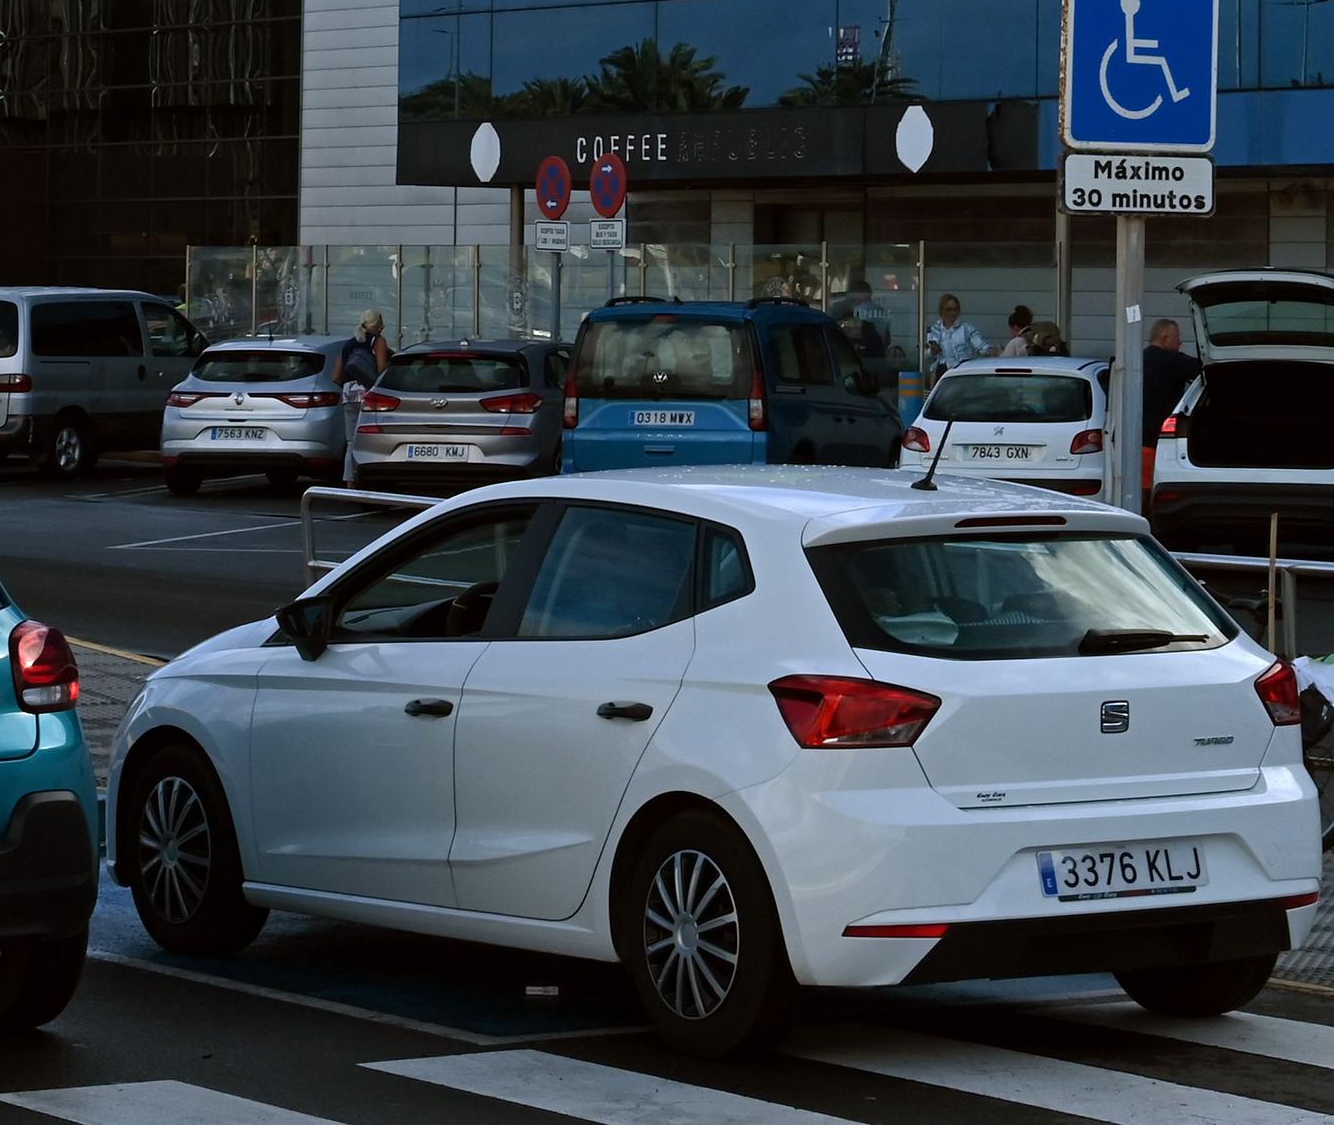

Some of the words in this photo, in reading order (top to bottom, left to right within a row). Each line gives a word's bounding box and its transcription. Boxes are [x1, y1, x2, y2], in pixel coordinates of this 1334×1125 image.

[576, 133, 668, 163] COFFEE
[1094, 159, 1185, 182] Máximo
[1072, 187, 1102, 207] 30
[1112, 189, 1207, 210] minutos
[636, 412, 667, 424] 0318
[669, 412, 693, 424] MWX
[217, 429, 243, 439] 7563
[244, 429, 264, 439] KNZ
[414, 446, 439, 457] 6680
[445, 446, 465, 458] KMJ
[971, 447, 1001, 459] 7843
[1006, 447, 1030, 459] GXN
[1060, 852, 1138, 889] 3376
[1145, 846, 1203, 883] KLJ
